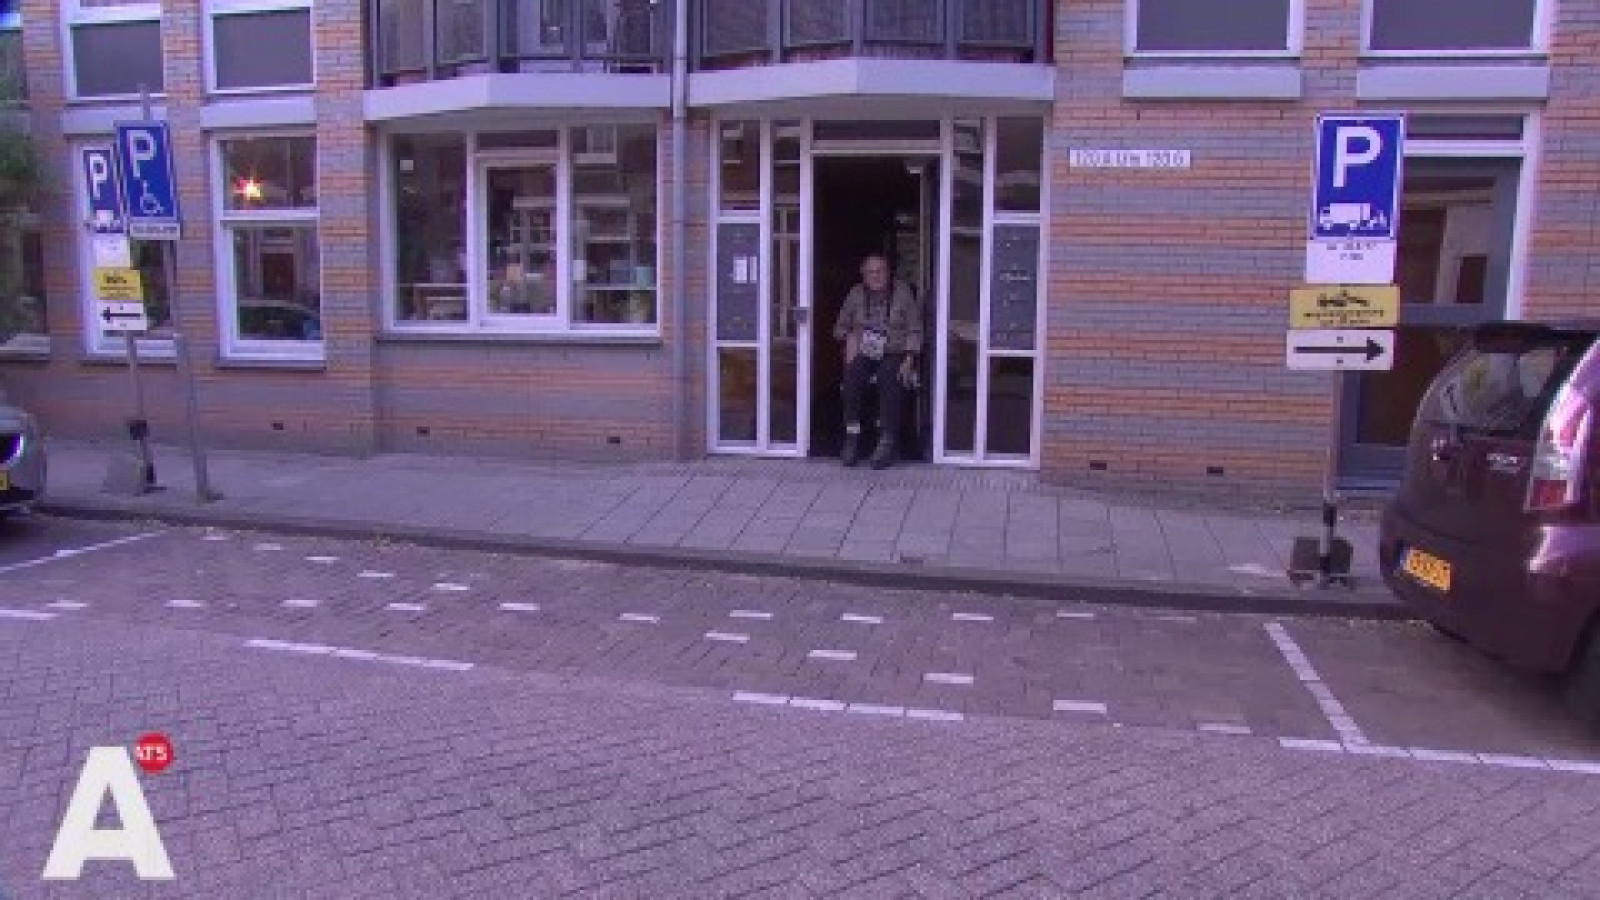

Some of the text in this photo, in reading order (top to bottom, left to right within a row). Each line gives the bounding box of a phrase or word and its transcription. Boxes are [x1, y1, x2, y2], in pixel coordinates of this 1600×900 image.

[90, 153, 107, 197] P
[127, 130, 158, 179] P
[1333, 126, 1381, 187] P
